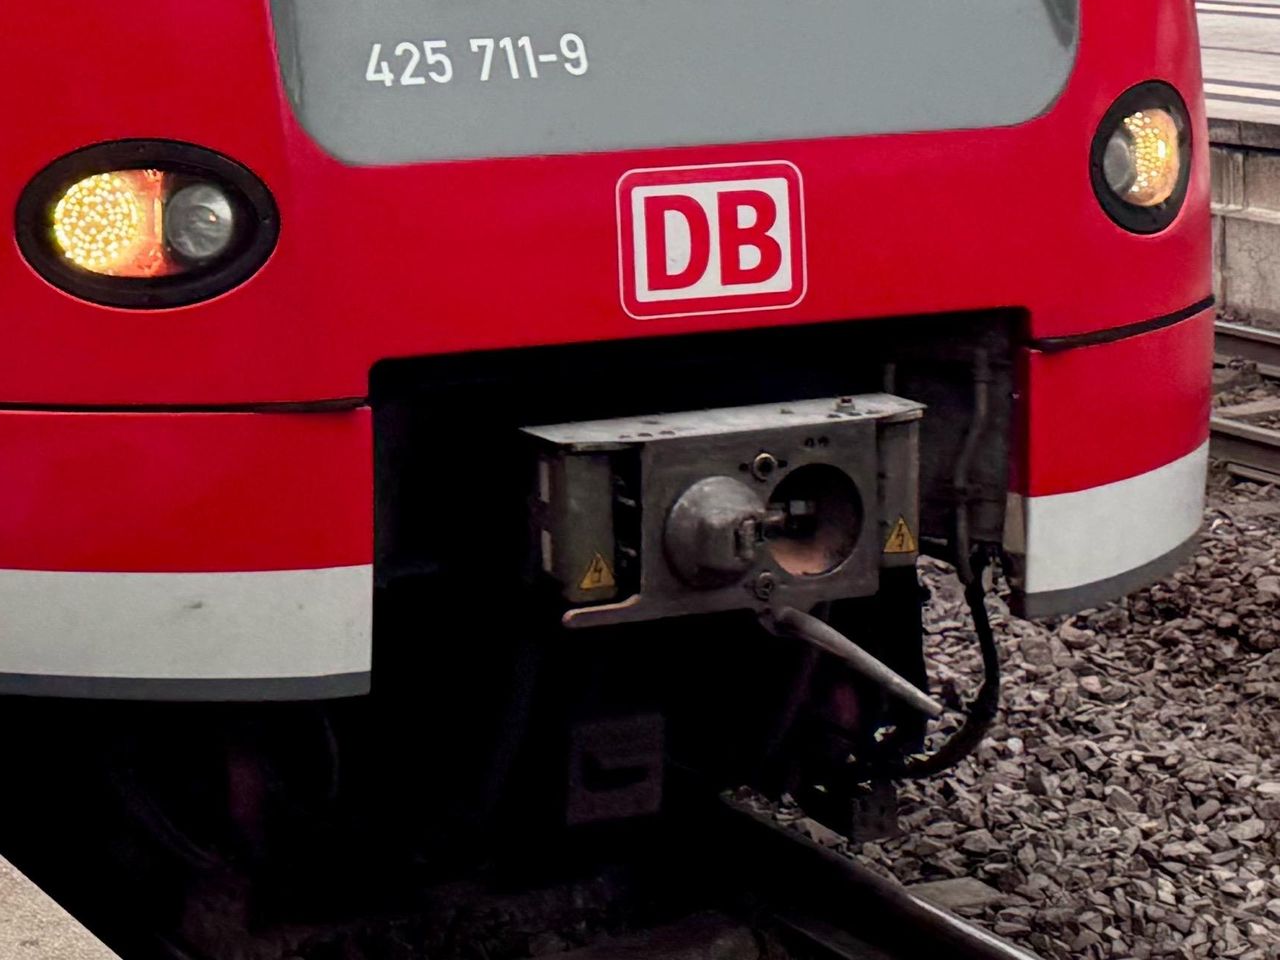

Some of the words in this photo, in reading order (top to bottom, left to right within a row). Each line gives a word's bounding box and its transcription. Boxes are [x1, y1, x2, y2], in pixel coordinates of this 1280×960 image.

[365, 40, 453, 87] 425
[469, 32, 588, 82] 711-9
[643, 189, 783, 292] DB
